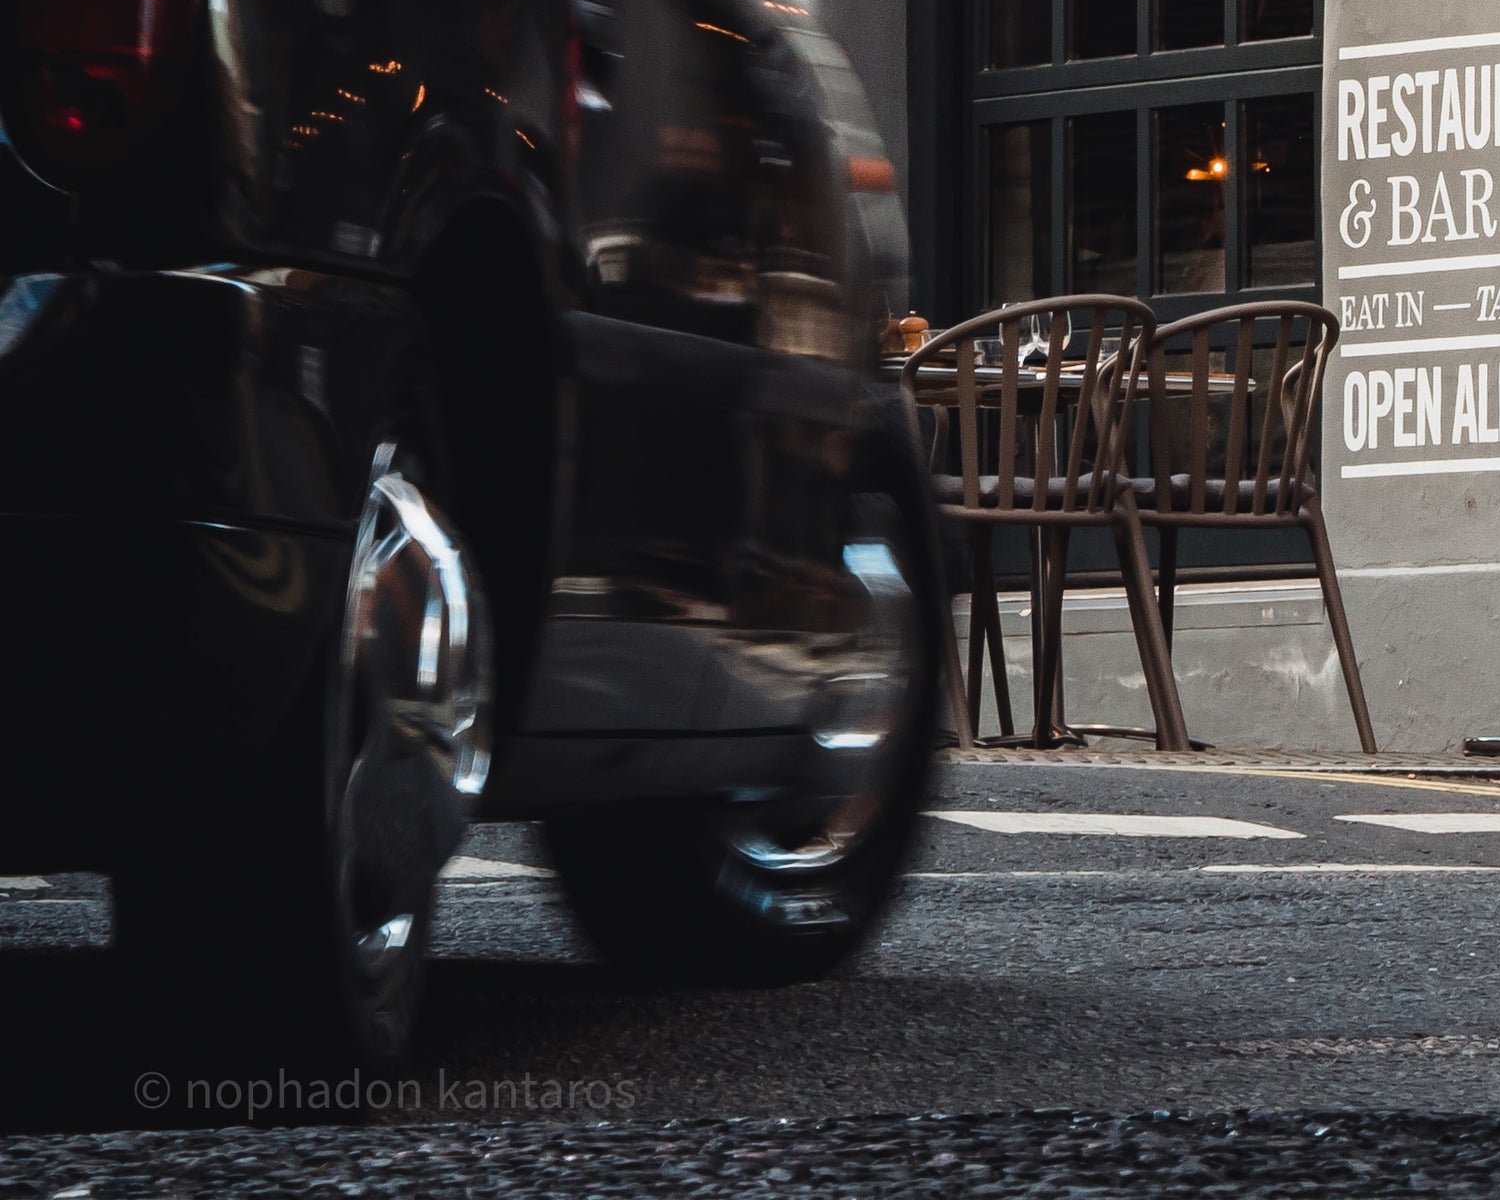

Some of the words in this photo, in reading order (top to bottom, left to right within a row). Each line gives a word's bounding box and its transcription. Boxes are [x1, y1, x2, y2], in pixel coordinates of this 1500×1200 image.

[1339, 179, 1377, 248] &
[1387, 169, 1498, 246] BAR
[1340, 292, 1390, 332] EAT
[1395, 291, 1424, 328] IN
[1343, 366, 1442, 452] OPEN
